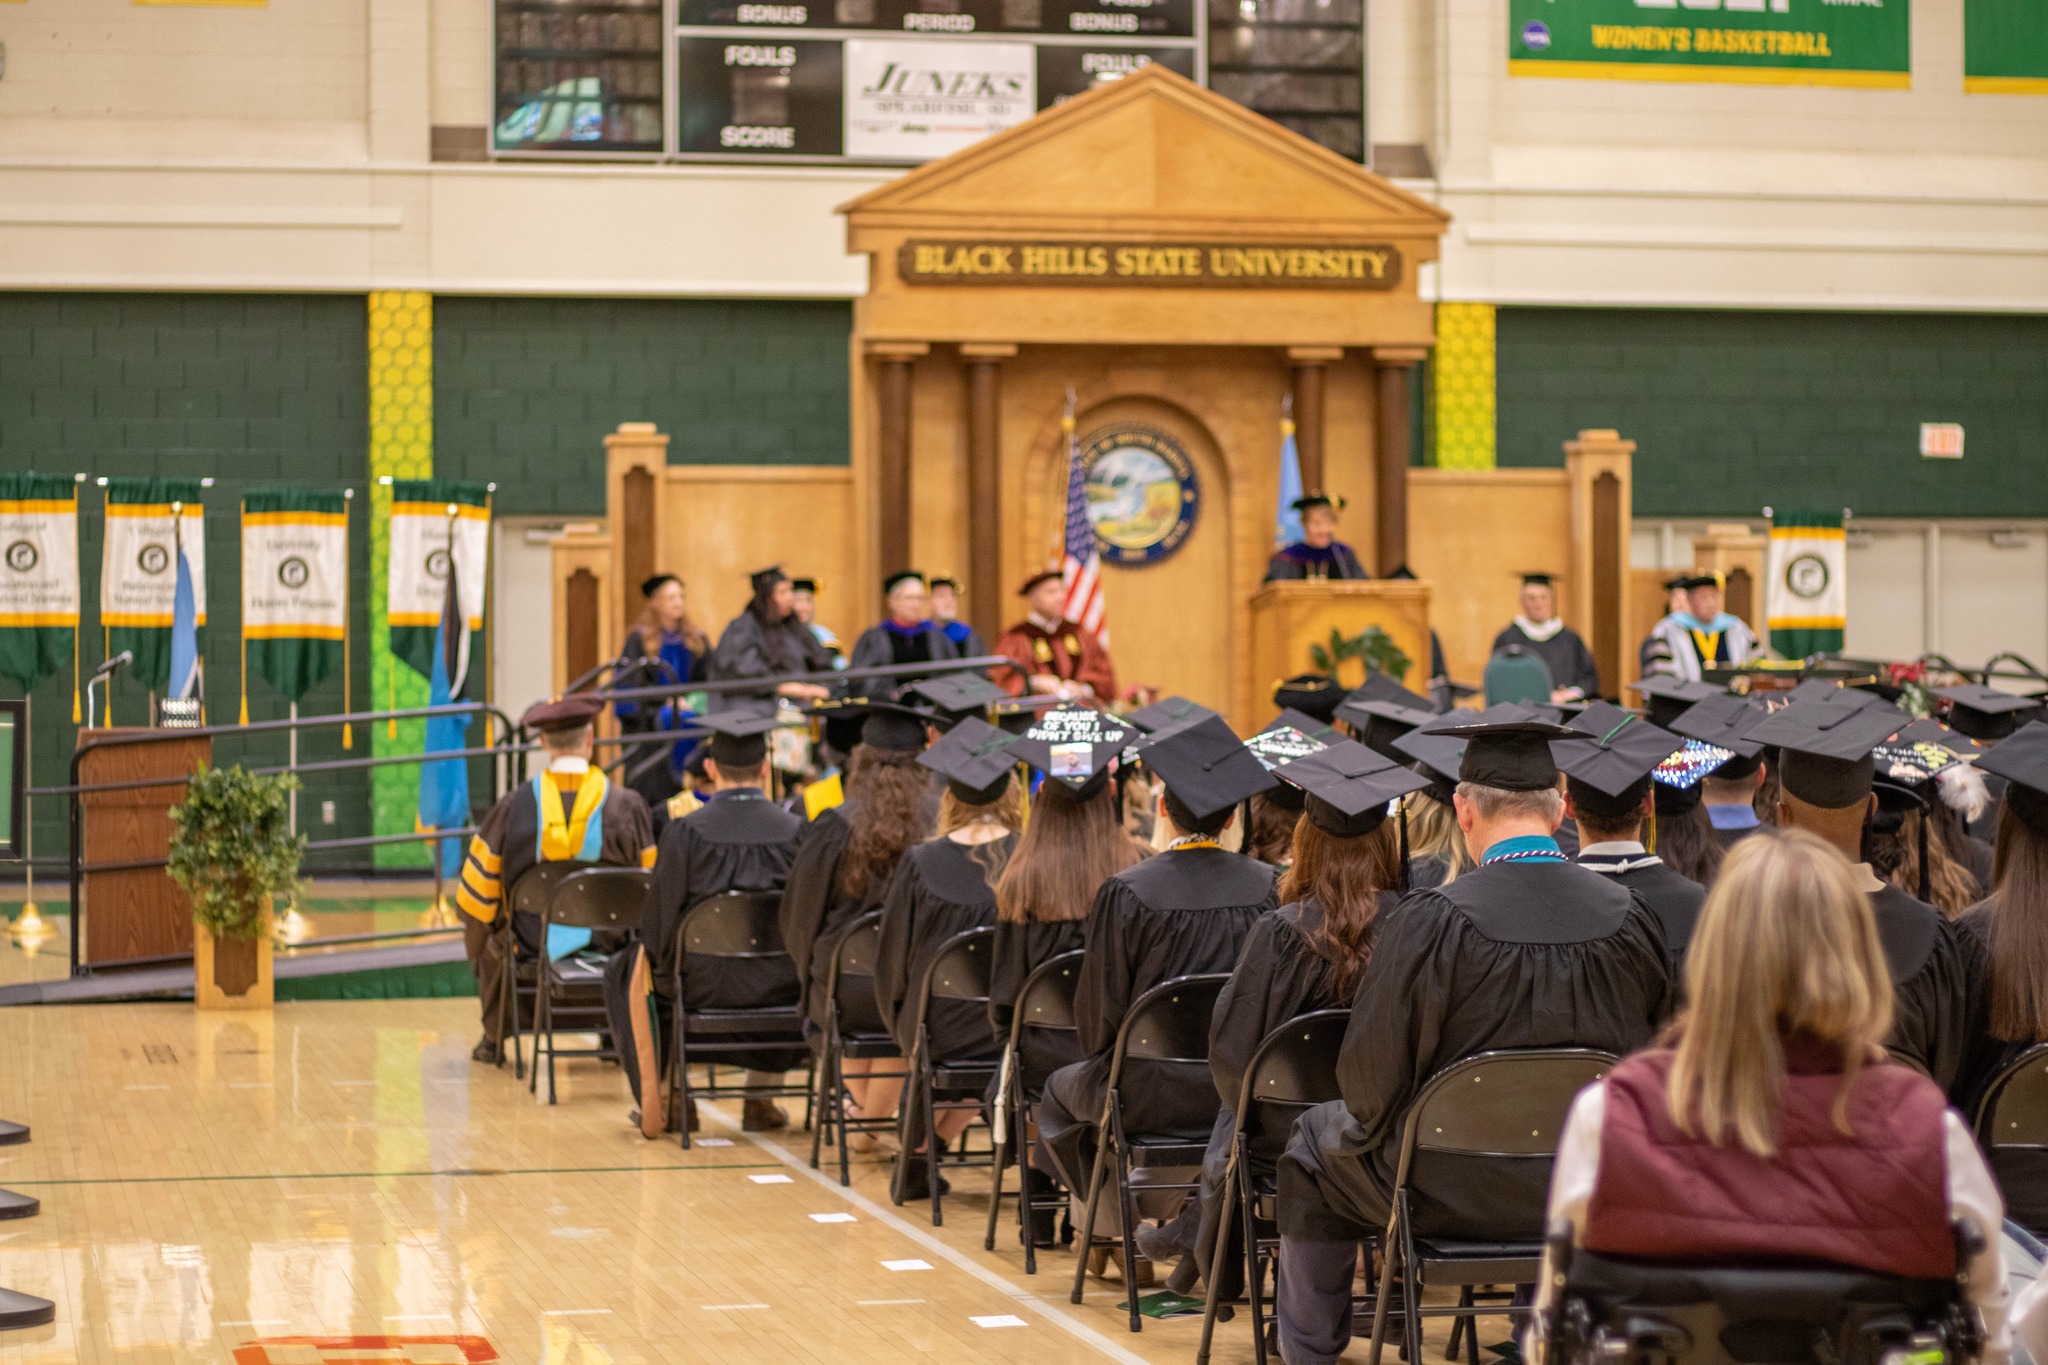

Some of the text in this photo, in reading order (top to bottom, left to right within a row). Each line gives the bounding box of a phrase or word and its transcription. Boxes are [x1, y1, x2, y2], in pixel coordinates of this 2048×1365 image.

[737, 4, 807, 23] BONUS
[903, 13, 975, 31] PERIOD
[1069, 12, 1139, 32] BONUS
[1591, 25, 1832, 57] WOMEN'S BASKETBALL
[724, 46, 796, 66] FOULS
[1082, 53, 1152, 73] FOULS
[863, 62, 1028, 96] JUNEKS
[720, 126, 796, 147] SCORE
[914, 245, 1388, 279] BLACK HILLS STATE UNIVERSITY
[1044, 710, 1098, 721] BECAUSE
[1043, 720, 1061, 731] OF
[1064, 721, 1091, 732] YOU
[1073, 731, 1102, 743] GIVE
[1104, 731, 1124, 743] UP
